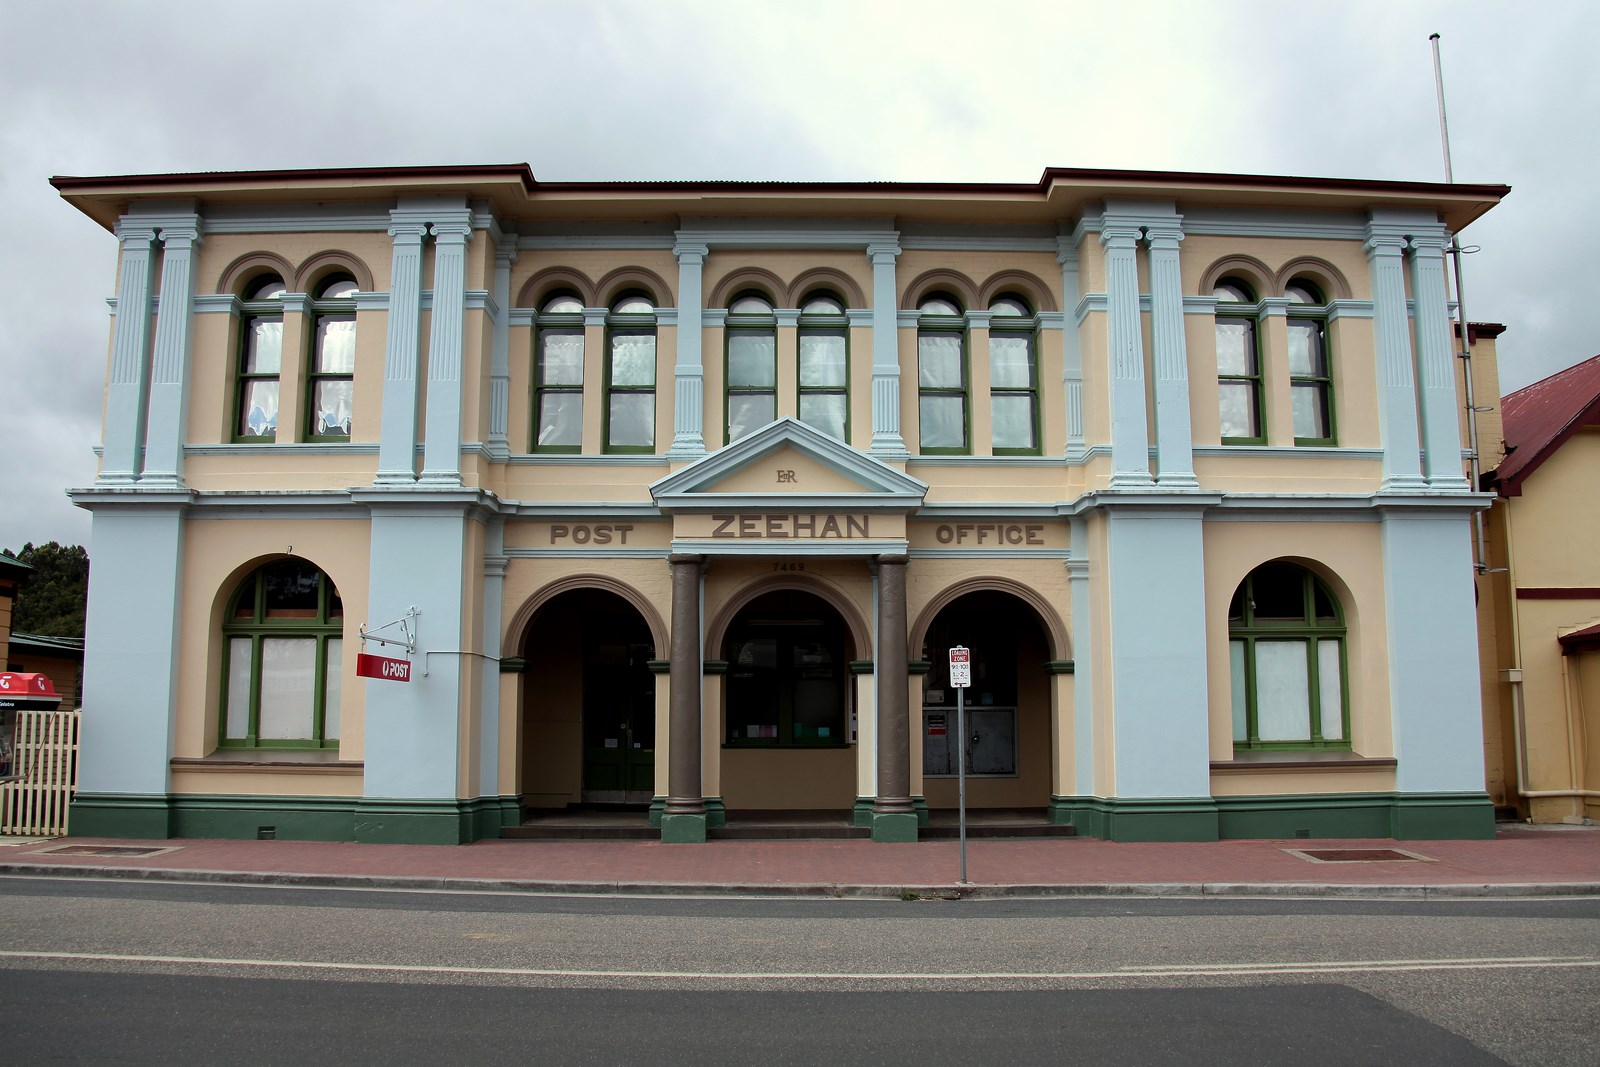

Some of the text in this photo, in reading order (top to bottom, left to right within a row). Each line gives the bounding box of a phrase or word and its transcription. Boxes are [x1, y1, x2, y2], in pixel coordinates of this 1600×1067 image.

[550, 525, 634, 545] POST
[711, 514, 869, 538] ZEEHAN
[936, 524, 1045, 545] OFFICE
[773, 562, 805, 571] 7469
[389, 662, 409, 678] POST
